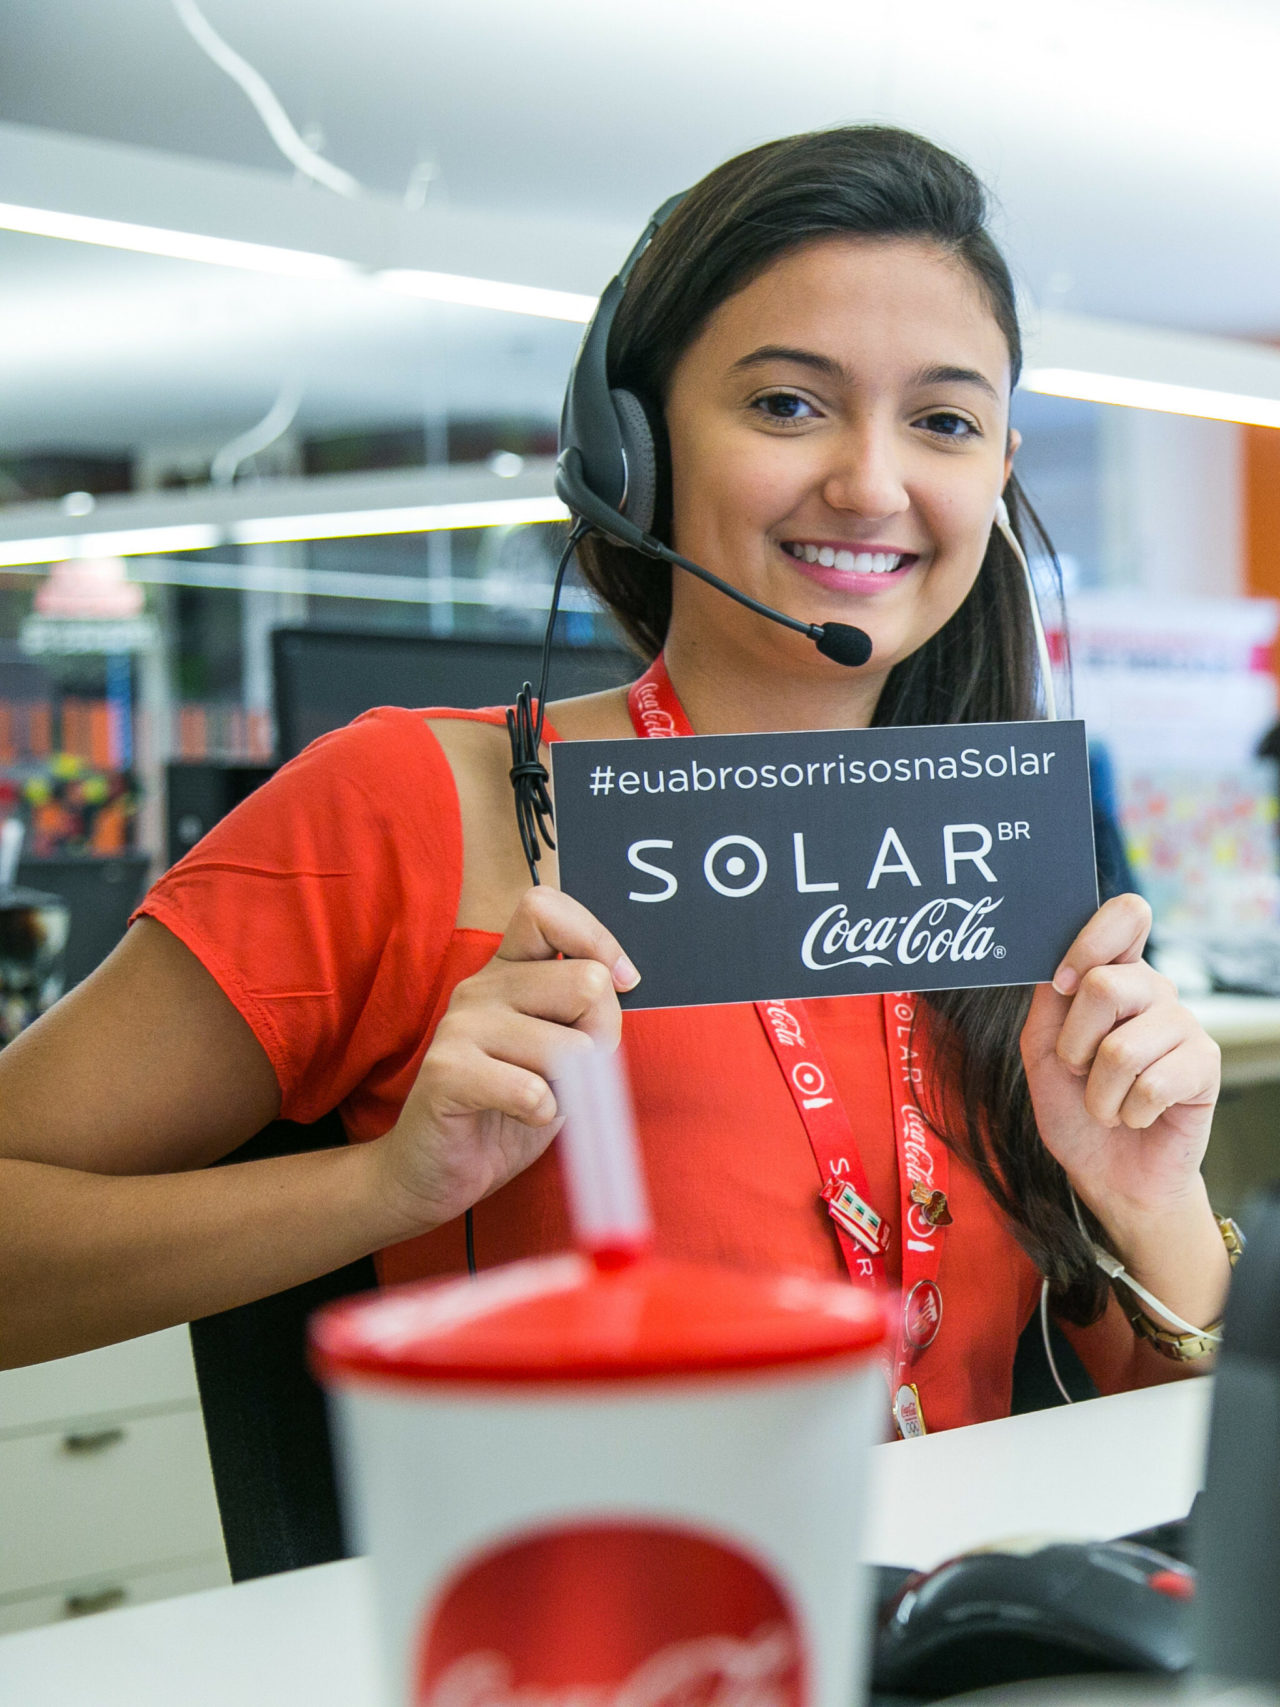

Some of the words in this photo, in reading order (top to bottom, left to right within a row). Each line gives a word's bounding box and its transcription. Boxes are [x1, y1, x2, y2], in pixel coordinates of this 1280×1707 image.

[589, 746, 1056, 796] #euabrosorrisosnaSolar
[626, 822, 999, 903] SOLAR
[997, 821, 1031, 841] BR
[801, 896, 1005, 971] Coca-Cola
[895, 992, 923, 1082] OLAR
